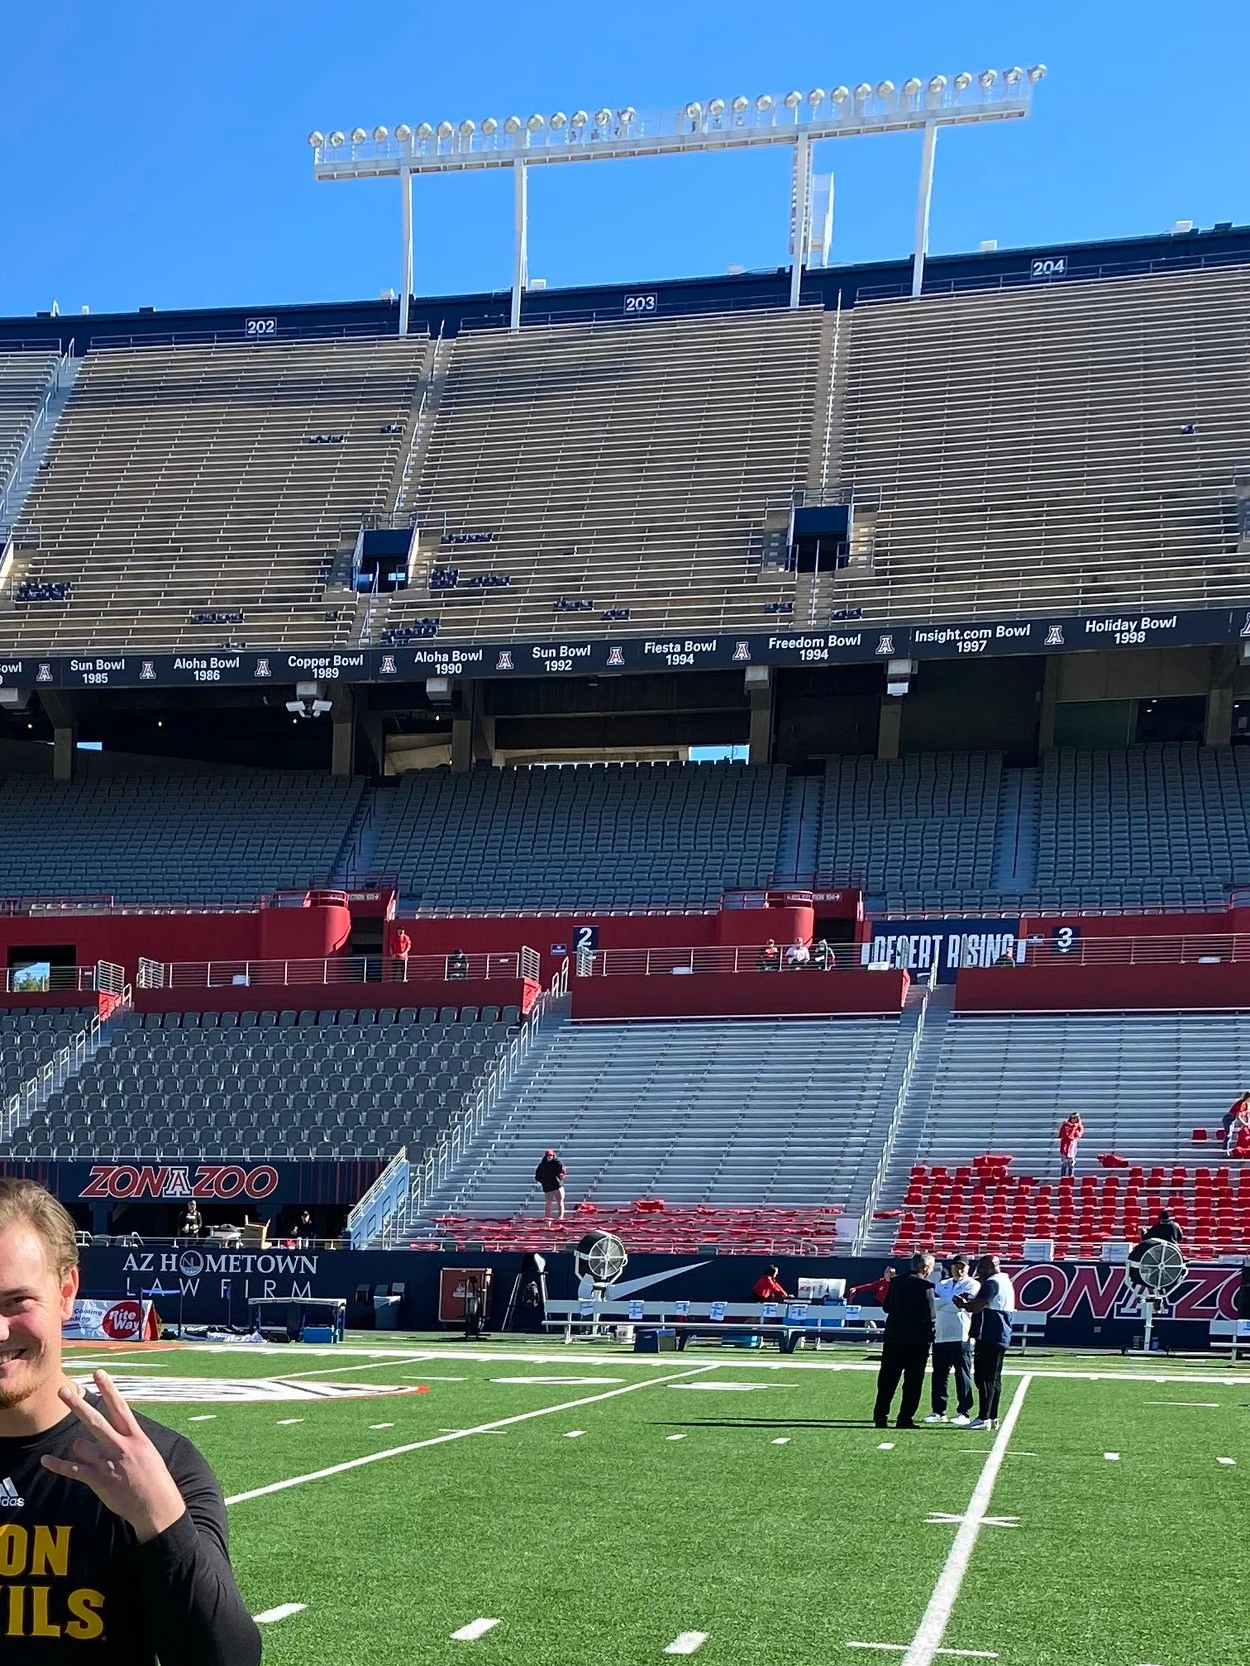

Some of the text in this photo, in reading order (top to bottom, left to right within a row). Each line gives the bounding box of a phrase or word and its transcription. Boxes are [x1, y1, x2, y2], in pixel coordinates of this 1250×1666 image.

[1033, 259, 1065, 276] 204
[626, 296, 655, 311] 203
[247, 320, 275, 334] 202
[1085, 615, 1178, 633] Holiday Bowl
[915, 623, 1031, 643] Insight.com Bowl
[1114, 630, 1146, 645] 1998
[644, 639, 717, 654] Fiesta Bowl
[768, 633, 862, 650] Freedom Bowl
[956, 639, 988, 653] 1997
[414, 649, 483, 663] Aloha Bowl
[531, 645, 591, 659] Sun Bowl
[799, 648, 829, 661] 1994
[70, 658, 126, 671] Sun Bowl
[173, 656, 240, 670] Aloha Bowl
[287, 654, 364, 669] Copper Bowl
[544, 660, 573, 672] 1992
[665, 653, 695, 666] 1994
[193, 670, 221, 681] 1986
[311, 667, 340, 679] 1989
[434, 663, 462, 675] 1990
[82, 673, 109, 684] 1985
[579, 927, 593, 946] 2
[1057, 927, 1073, 948] 3
[78, 1165, 279, 1199] ZONAZOO
[122, 1250, 319, 1277] AZ HOMETOWN
[125, 1277, 312, 1299] LAW FIRM
[109, 1309, 137, 1320] Rite
[113, 1318, 140, 1332] Way
